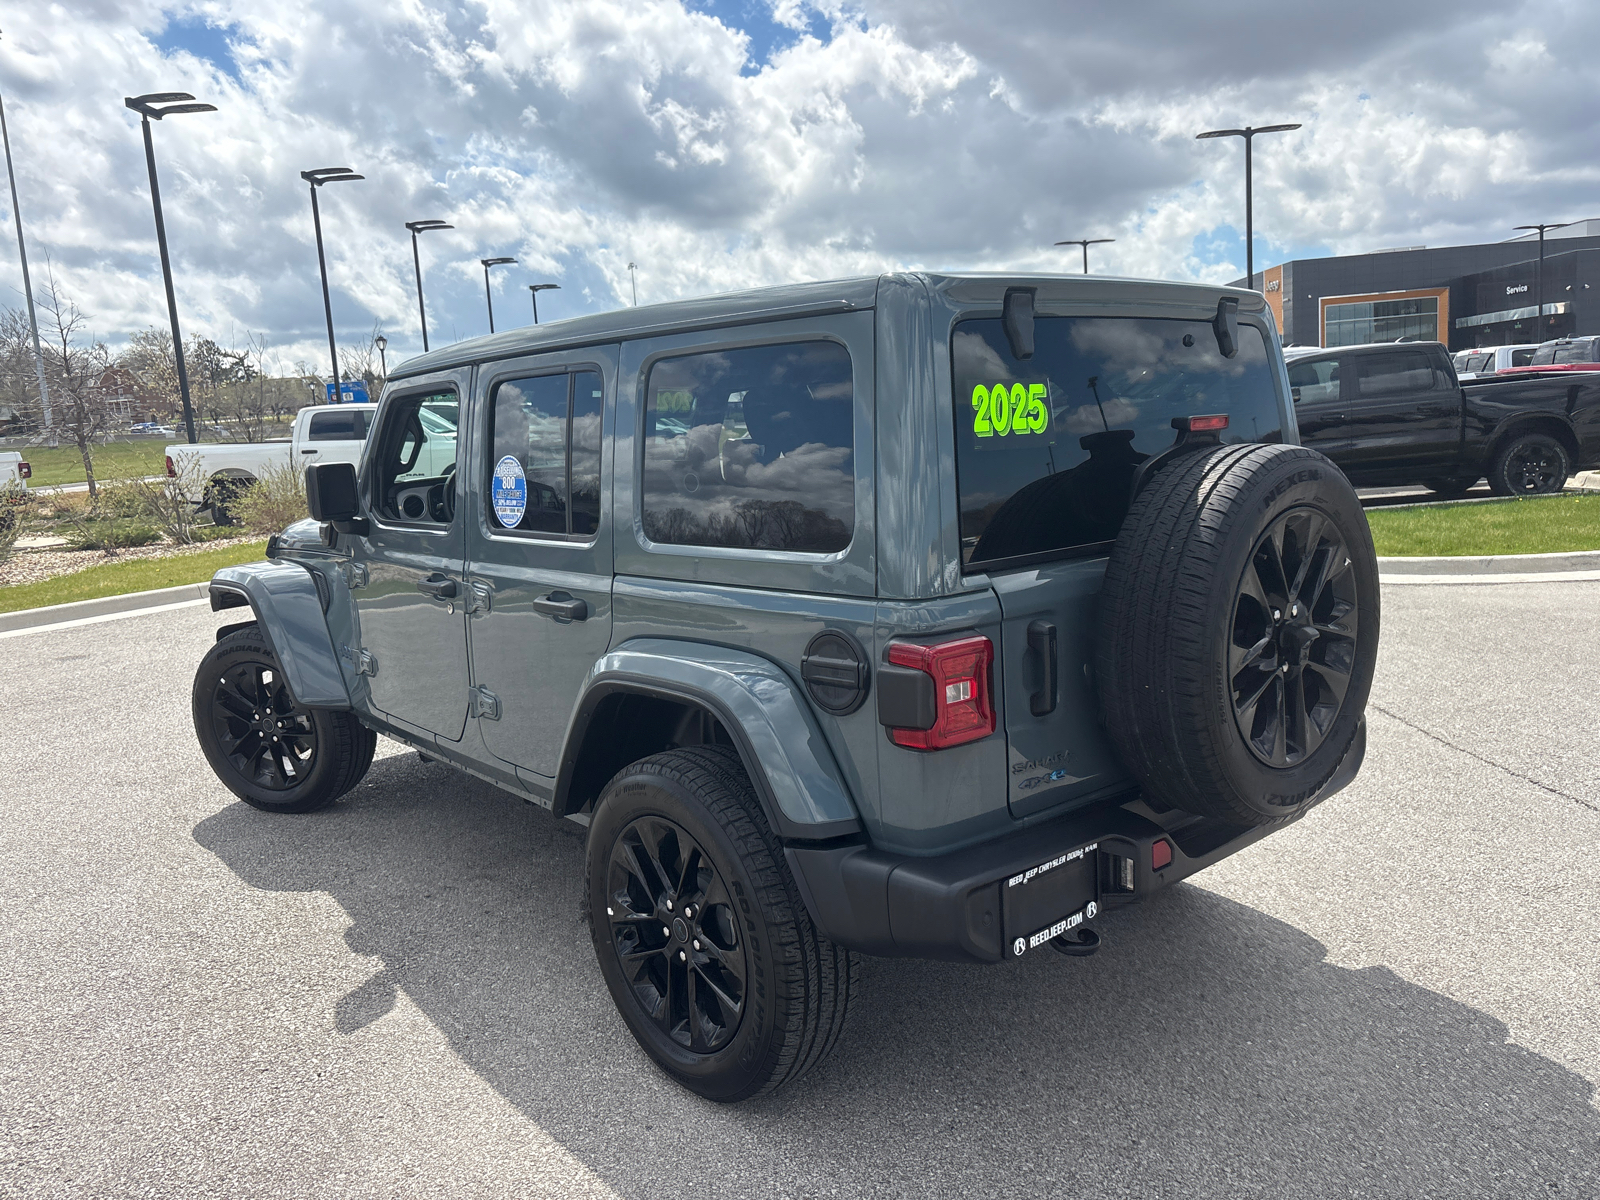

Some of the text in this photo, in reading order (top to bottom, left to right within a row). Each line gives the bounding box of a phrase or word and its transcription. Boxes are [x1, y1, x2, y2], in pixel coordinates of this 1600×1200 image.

[1506, 284, 1528, 295] Service
[971, 382, 1049, 438] 2025
[496, 490, 522, 499] MILE RANGE
[502, 476, 516, 489] 800
[1263, 469, 1319, 509] NEXEN
[216, 645, 261, 661] ROADIAN
[1008, 873, 1024, 888] REED
[1025, 867, 1039, 879] JEEP
[1038, 854, 1067, 874] CHRYSLER
[1084, 842, 1098, 854] RAM
[1029, 911, 1083, 949] REEDJEEP.COM
